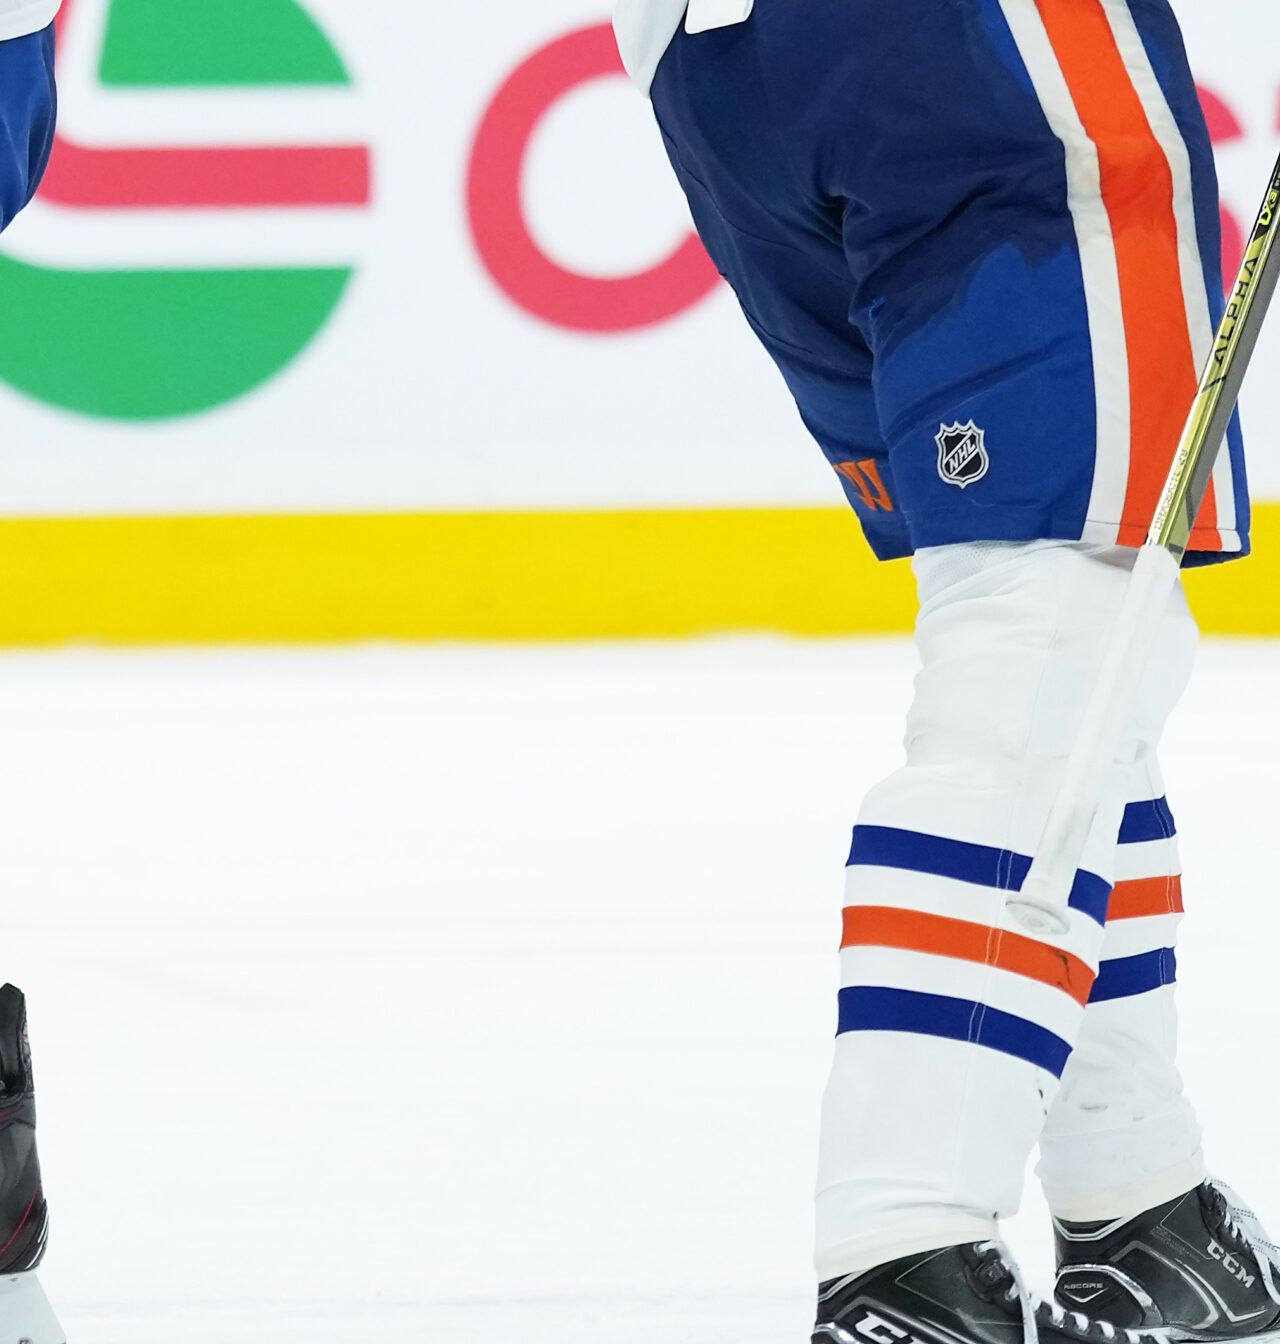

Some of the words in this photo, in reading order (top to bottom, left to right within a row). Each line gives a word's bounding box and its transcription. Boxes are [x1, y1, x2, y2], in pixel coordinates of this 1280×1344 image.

[1214, 256, 1260, 368] ALPHA
[948, 436, 977, 473] NHL
[1206, 1238, 1256, 1289] CCM
